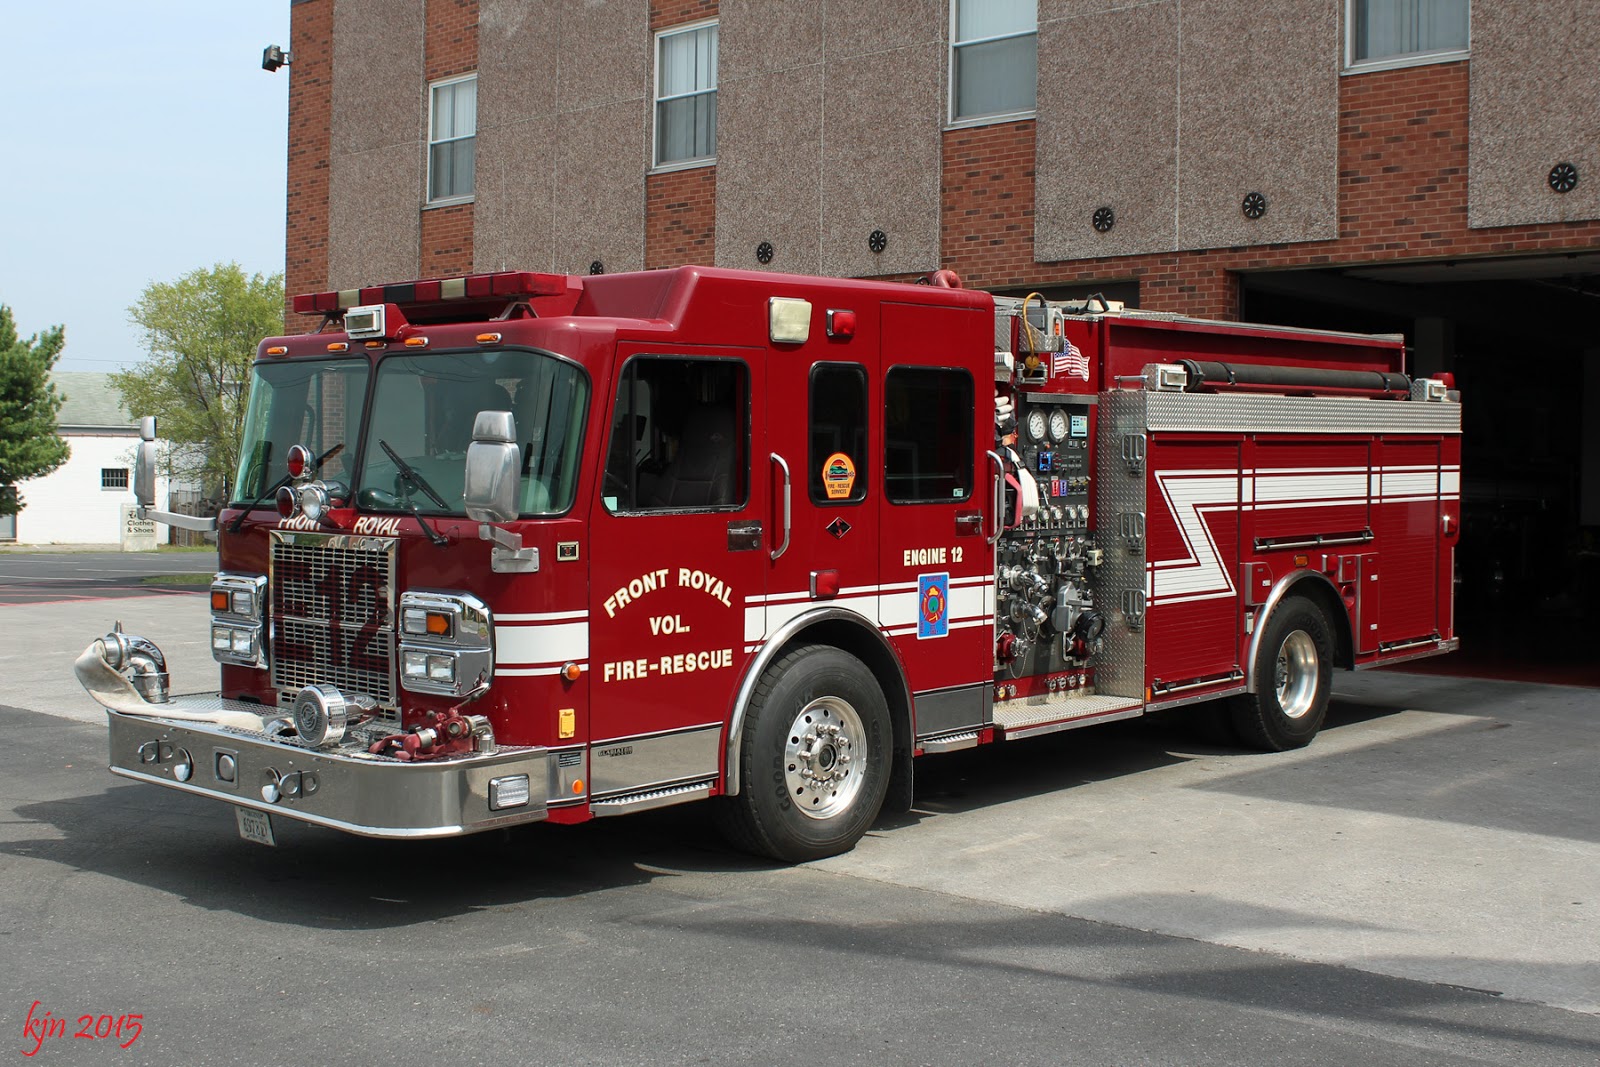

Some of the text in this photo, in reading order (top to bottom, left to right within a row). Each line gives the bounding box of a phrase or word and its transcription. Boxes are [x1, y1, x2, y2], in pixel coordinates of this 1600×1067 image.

[353, 516, 401, 536] ROYAL
[903, 546, 963, 566] ENGINE 12
[603, 567, 732, 619] FRONT ROYAL
[649, 614, 690, 636] VOL.
[603, 648, 733, 683] FIRE-RESCUE
